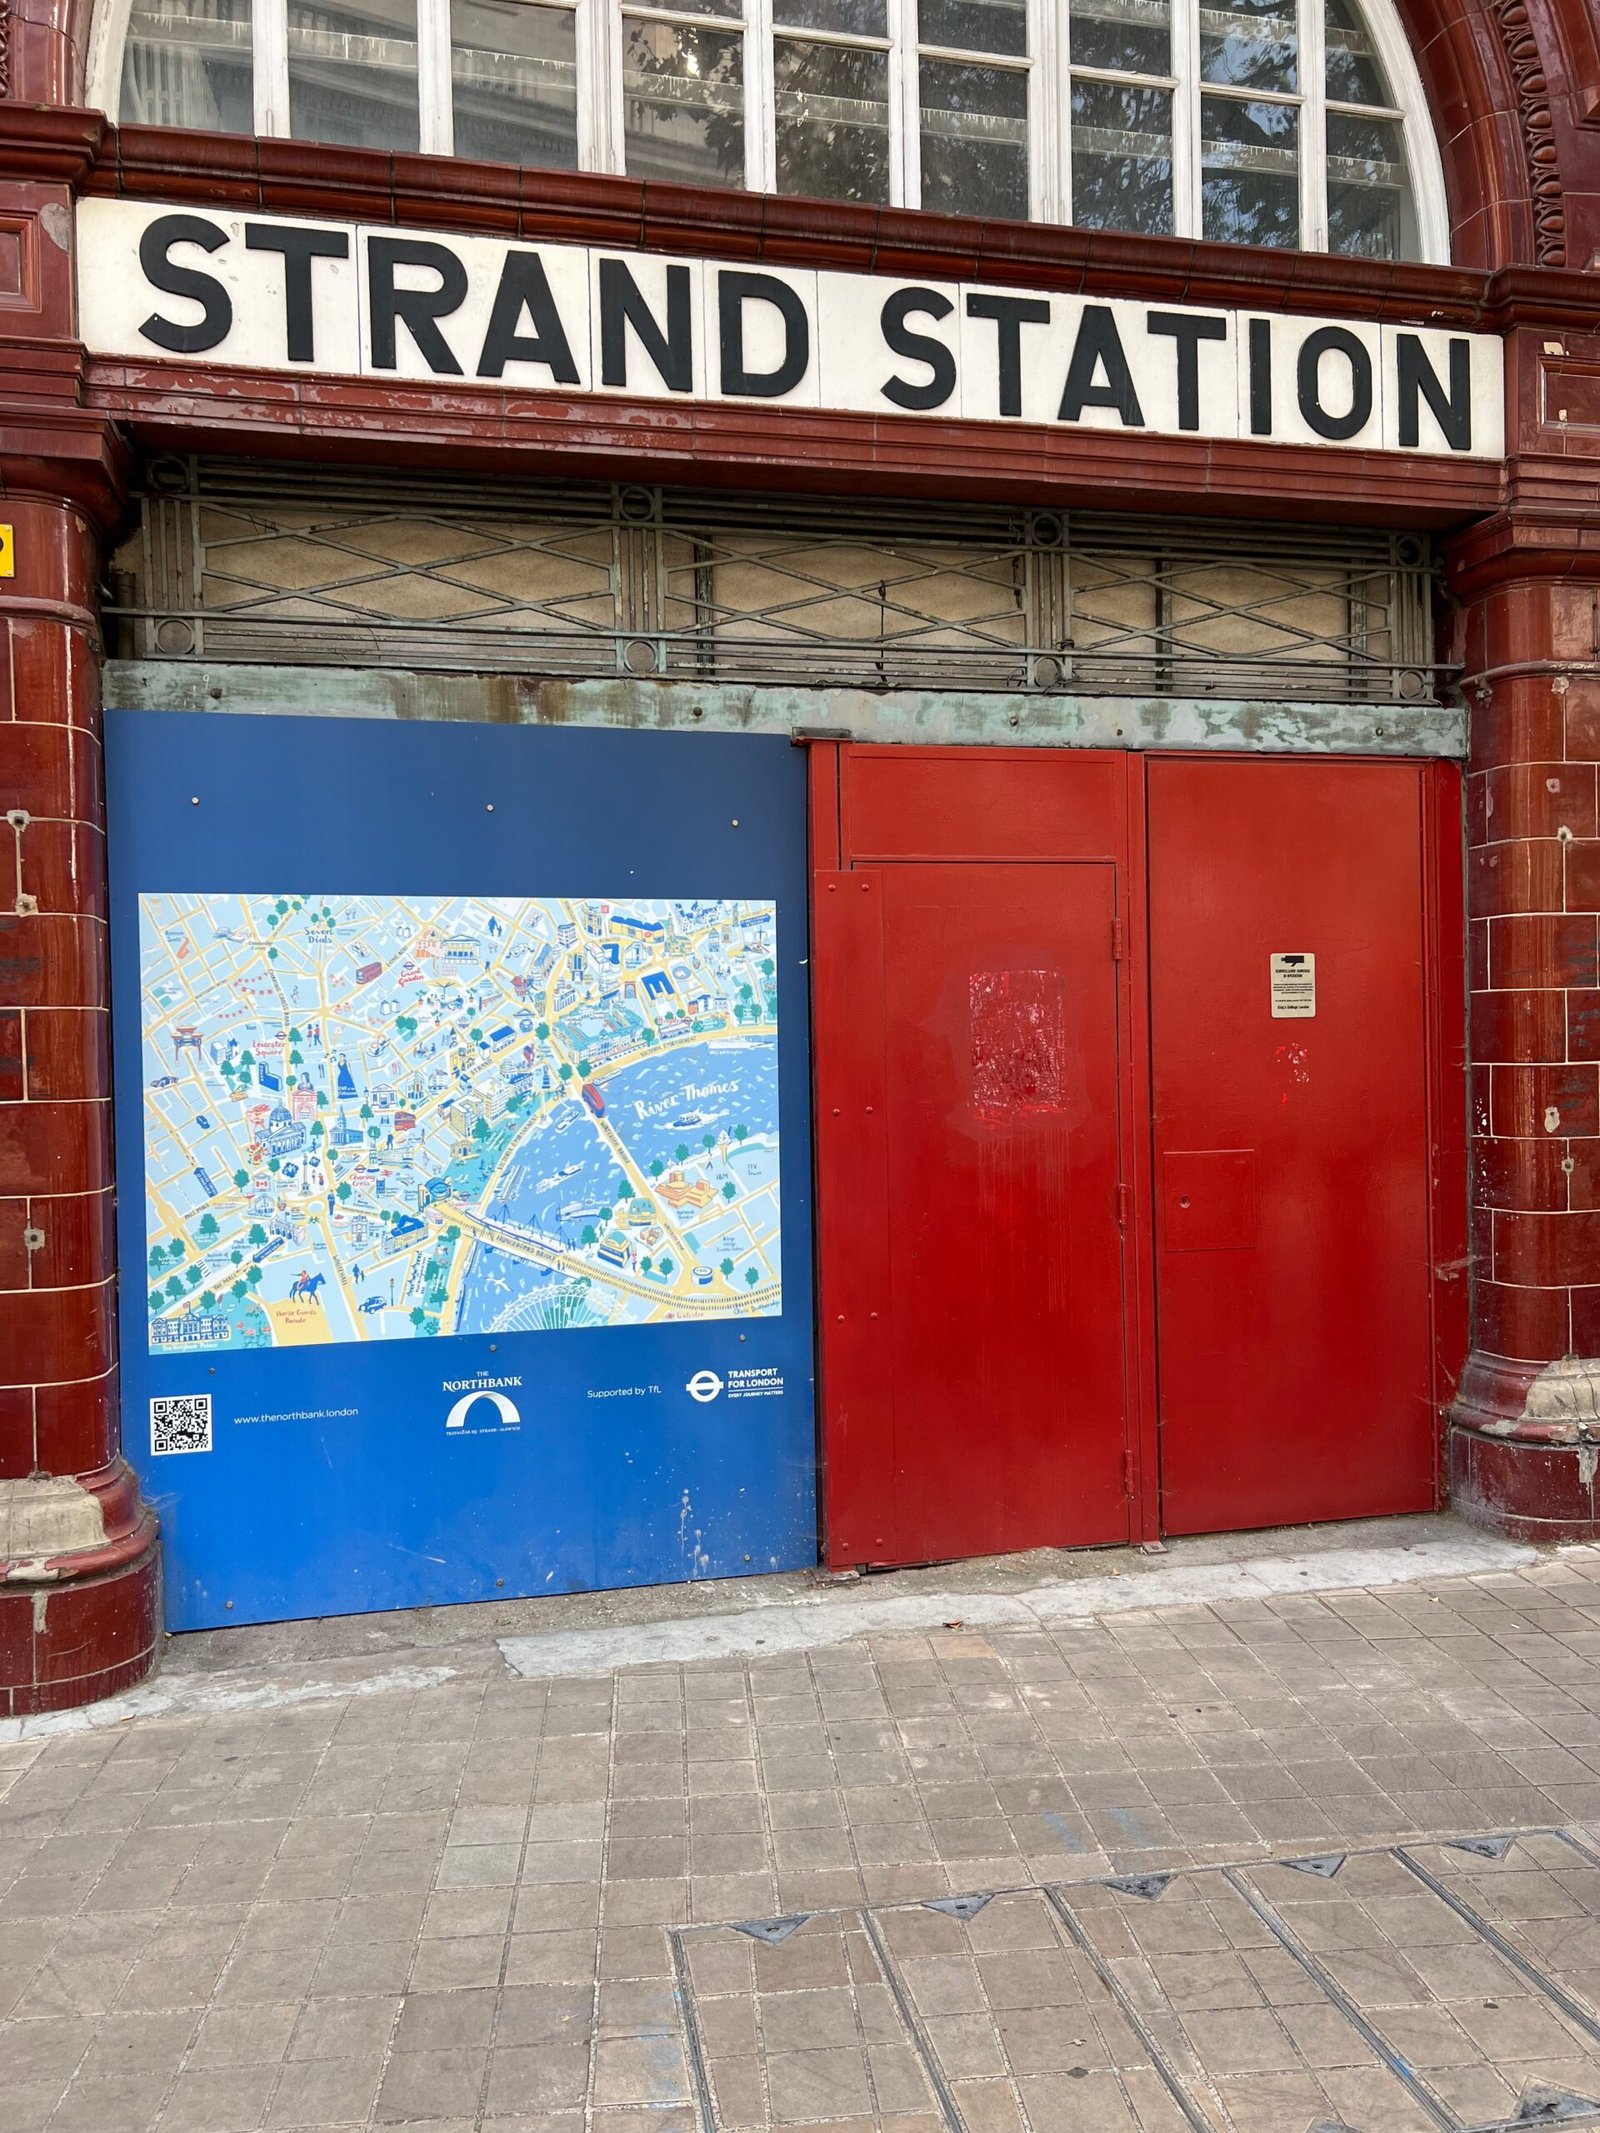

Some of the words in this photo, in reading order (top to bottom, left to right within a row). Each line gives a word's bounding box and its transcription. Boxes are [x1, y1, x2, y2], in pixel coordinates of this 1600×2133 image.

[138, 213, 810, 398] STRAND
[880, 286, 1472, 451] STATION
[304, 927, 333, 935] Seven
[308, 935, 333, 943] Dials
[252, 1040, 286, 1048] Leicester
[255, 1048, 282, 1058] Square
[470, 1059, 492, 1074] STRAND
[633, 1094, 679, 1120] River
[680, 1080, 739, 1101] Thames
[349, 1173, 376, 1182] Charing
[296, 1308, 317, 1316] Guards
[284, 1316, 306, 1324] Parade
[728, 1367, 778, 1379] TRANSPORT
[442, 1376, 523, 1392] NORTHBANK
[728, 1380, 745, 1389] FOR
[746, 1377, 784, 1387] LONDON
[587, 1387, 633, 1399] Supported
[634, 1387, 646, 1396] by
[648, 1385, 662, 1394] TfL
[233, 1408, 359, 1424] www.thenorthbank.london
